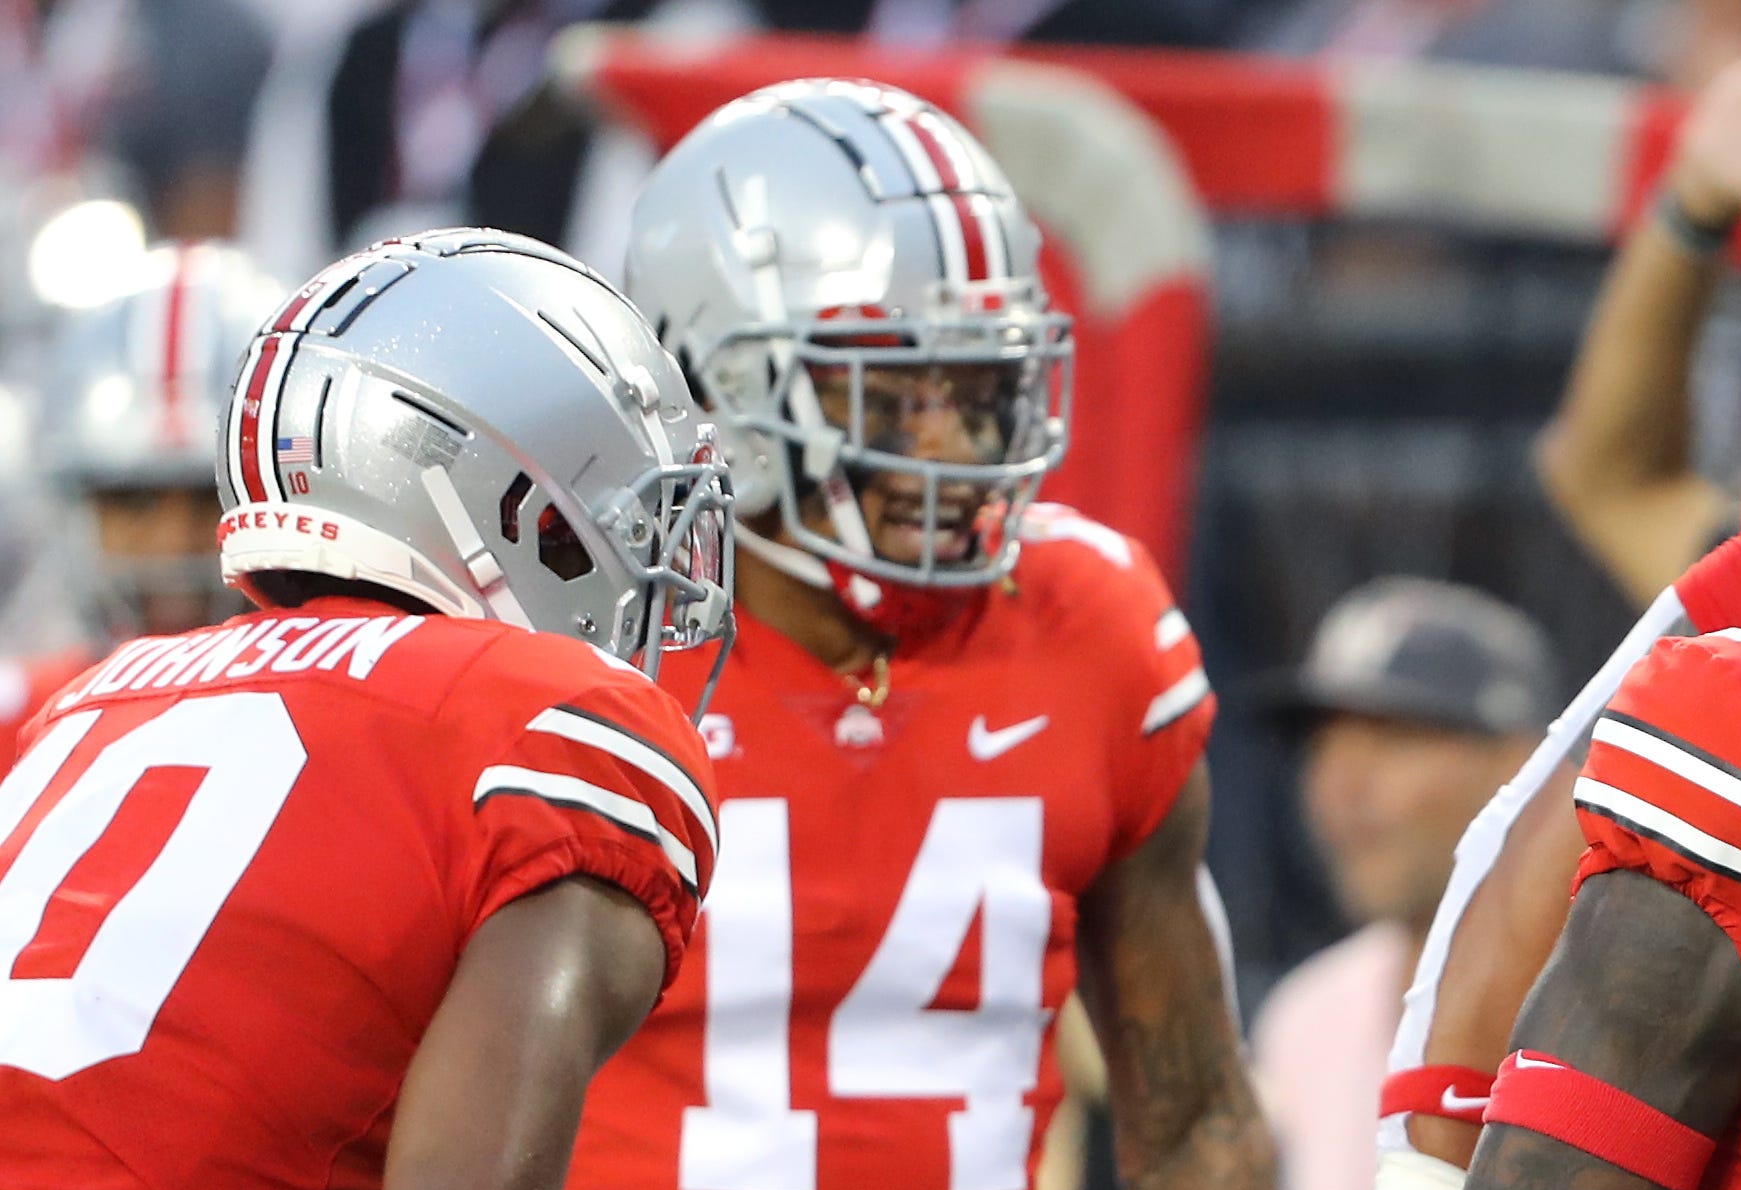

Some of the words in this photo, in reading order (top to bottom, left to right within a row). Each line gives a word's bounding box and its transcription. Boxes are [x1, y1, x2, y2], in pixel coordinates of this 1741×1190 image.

[288, 471, 310, 495] 10
[217, 510, 340, 549] CKEYES
[56, 613, 427, 711] JOHNSON
